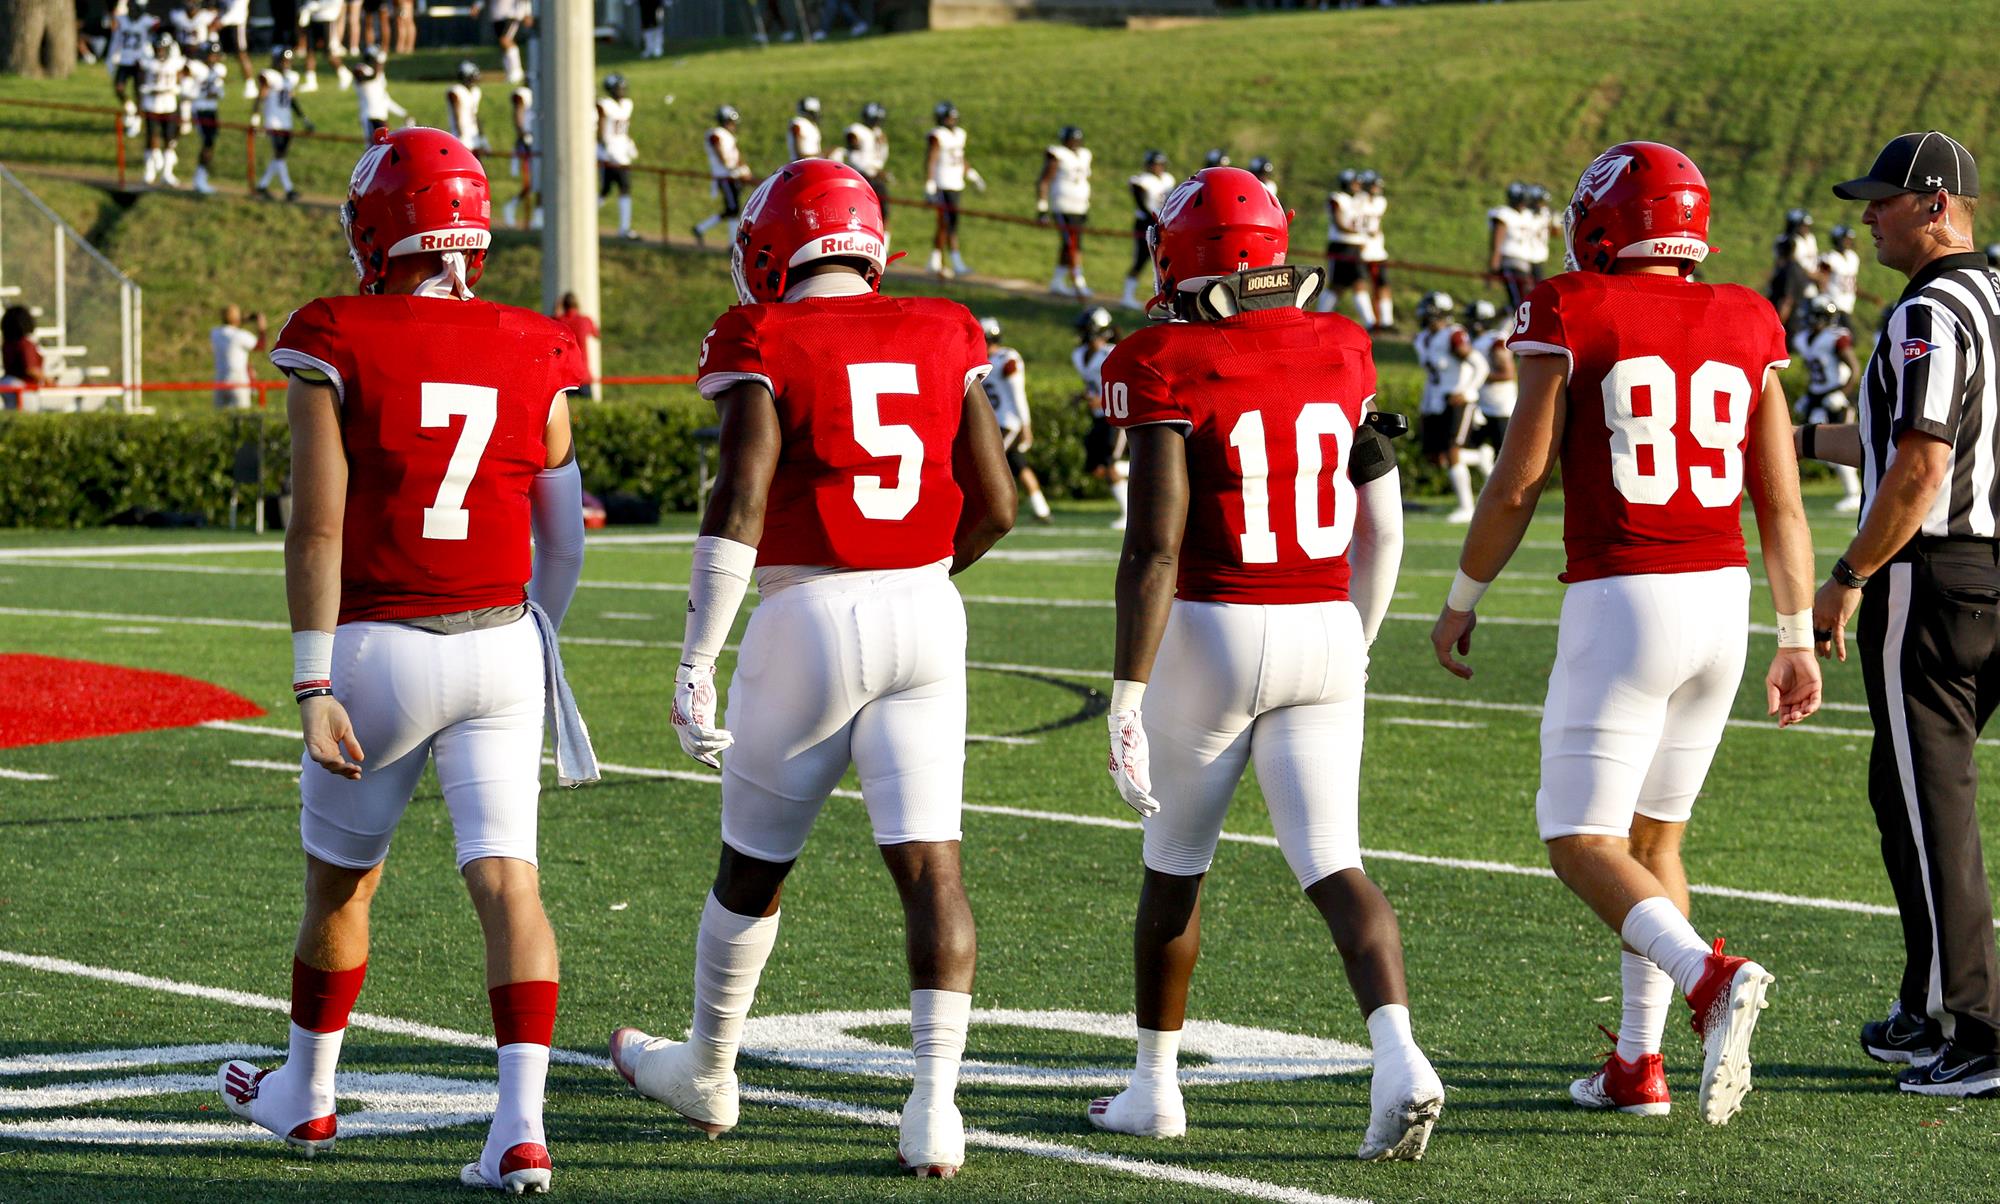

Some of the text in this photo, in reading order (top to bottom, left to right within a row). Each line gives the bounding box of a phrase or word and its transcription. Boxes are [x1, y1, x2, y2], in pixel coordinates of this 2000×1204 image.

[420, 233, 484, 250] Riddell
[1653, 241, 1706, 259] Riddell
[1247, 272, 1290, 291] DOUGLAS
[1514, 301, 1531, 335] 9
[699, 327, 717, 368] 5
[1104, 381, 1129, 419] 10
[846, 362, 925, 521] 5
[1601, 356, 1753, 507] 89
[420, 382, 499, 540] 7
[1229, 402, 1358, 565] 10
